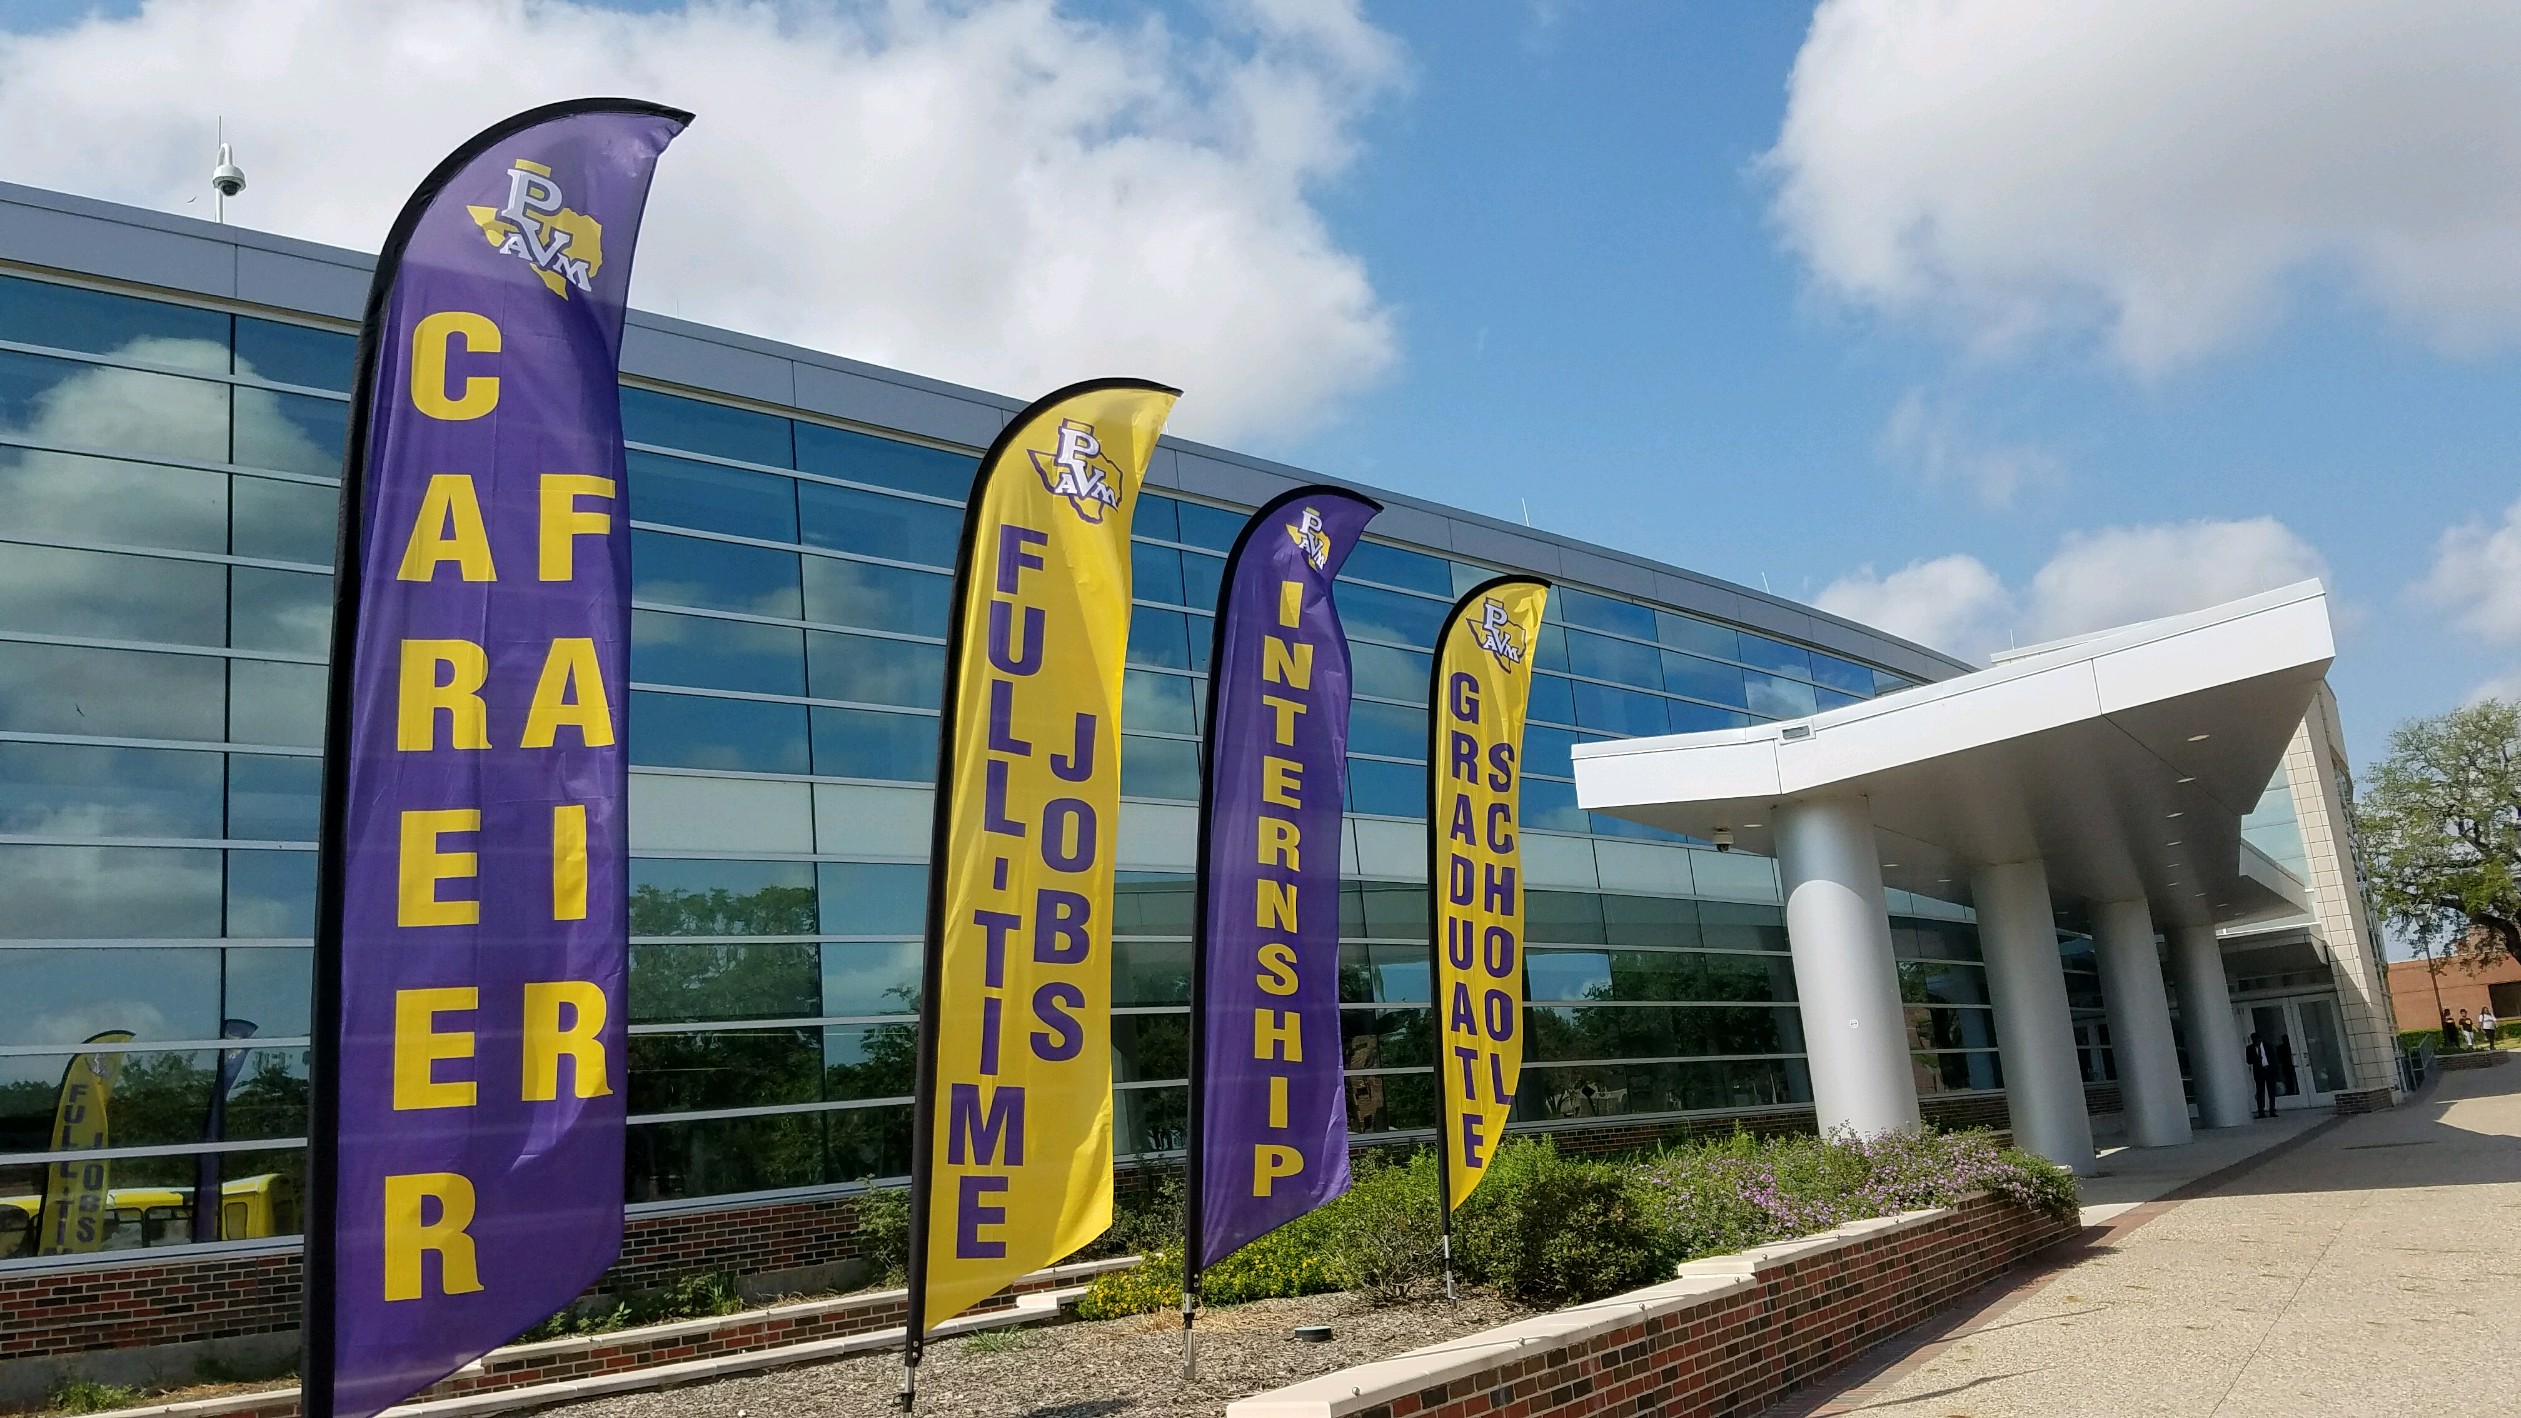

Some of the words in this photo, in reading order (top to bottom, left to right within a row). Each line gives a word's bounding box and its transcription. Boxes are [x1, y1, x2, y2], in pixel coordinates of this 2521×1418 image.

[384, 311, 502, 1301] CAREER
[519, 473, 617, 1102] FAIR
[947, 523, 1049, 1259] FULL-TIME
[1029, 712, 1098, 1062] JOBS
[1252, 580, 1314, 1197] INTERNSHIP
[1449, 671, 1484, 1168] GRADUATE
[1484, 742, 1516, 1105] SCHOOL
